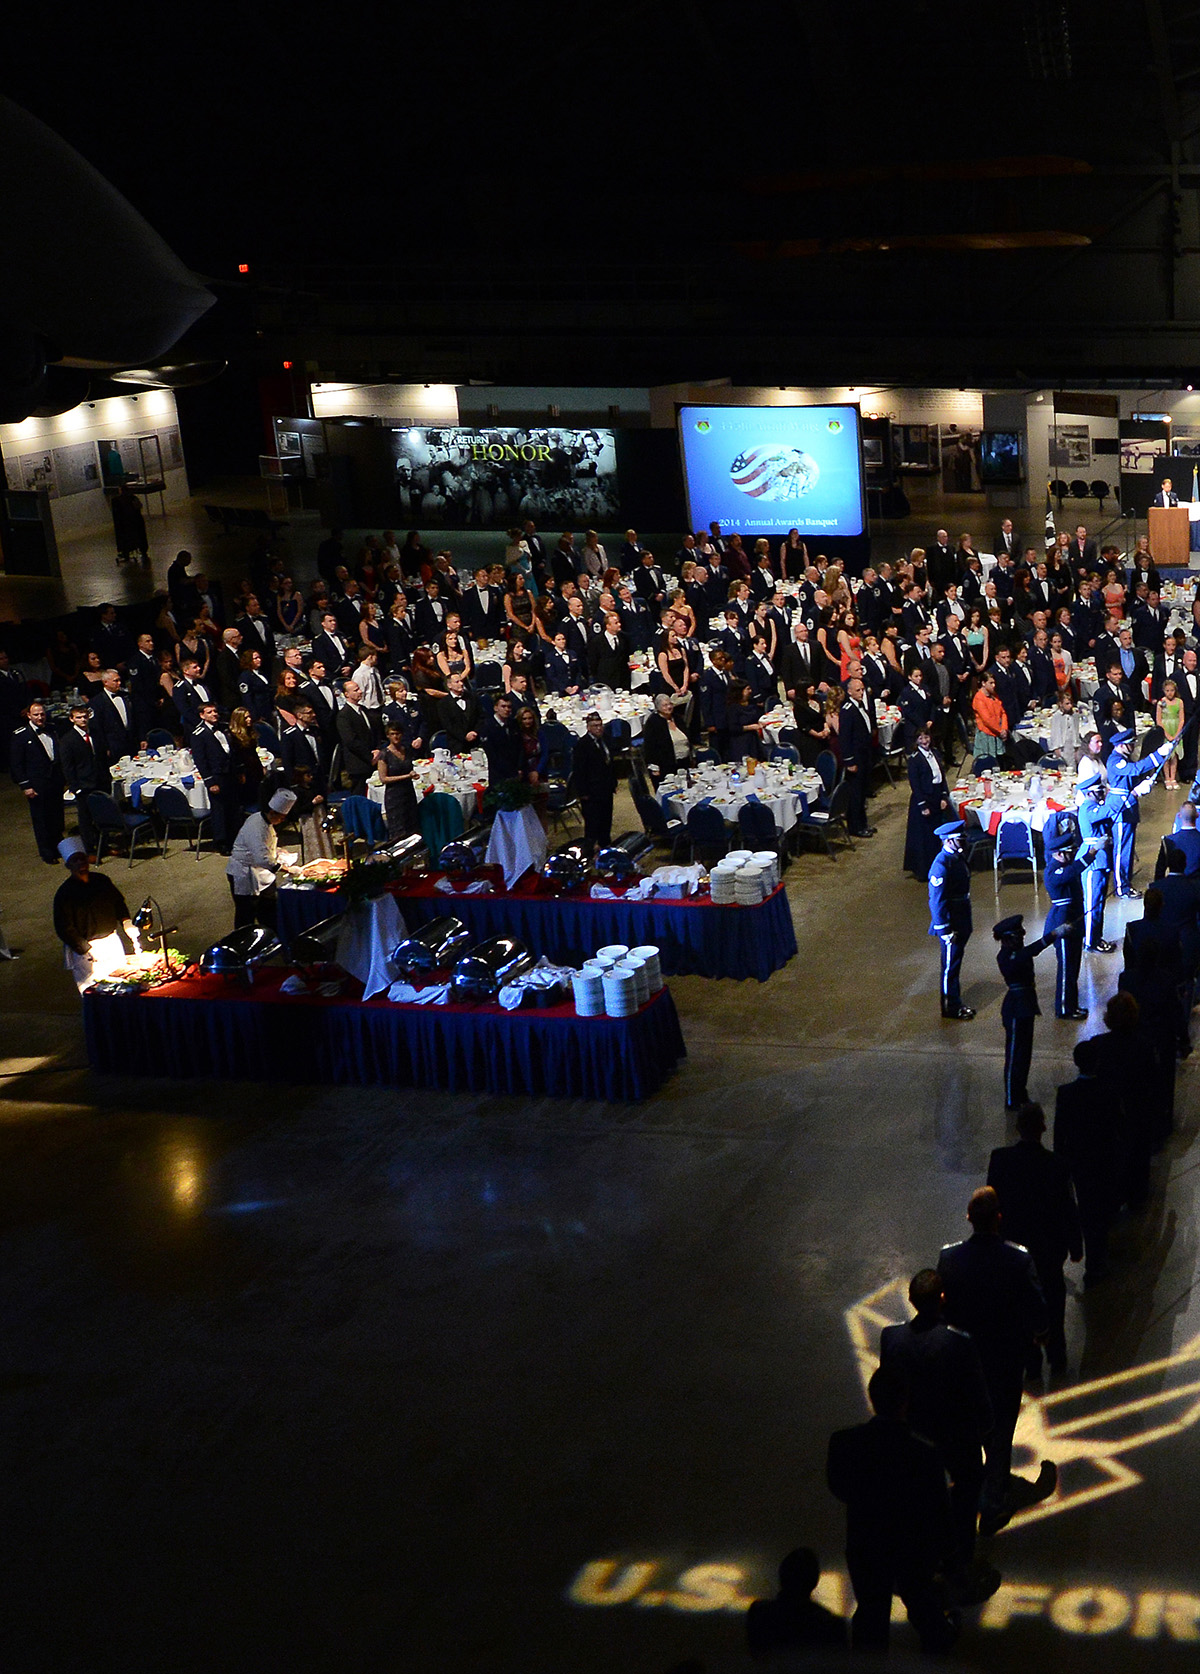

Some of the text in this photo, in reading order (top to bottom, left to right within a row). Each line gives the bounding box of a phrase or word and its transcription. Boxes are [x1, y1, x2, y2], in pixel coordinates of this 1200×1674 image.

[457, 434, 490, 444] RETURN
[472, 443, 554, 462] HONOR
[718, 518, 838, 528] 2014 Annual Awards Banquet
